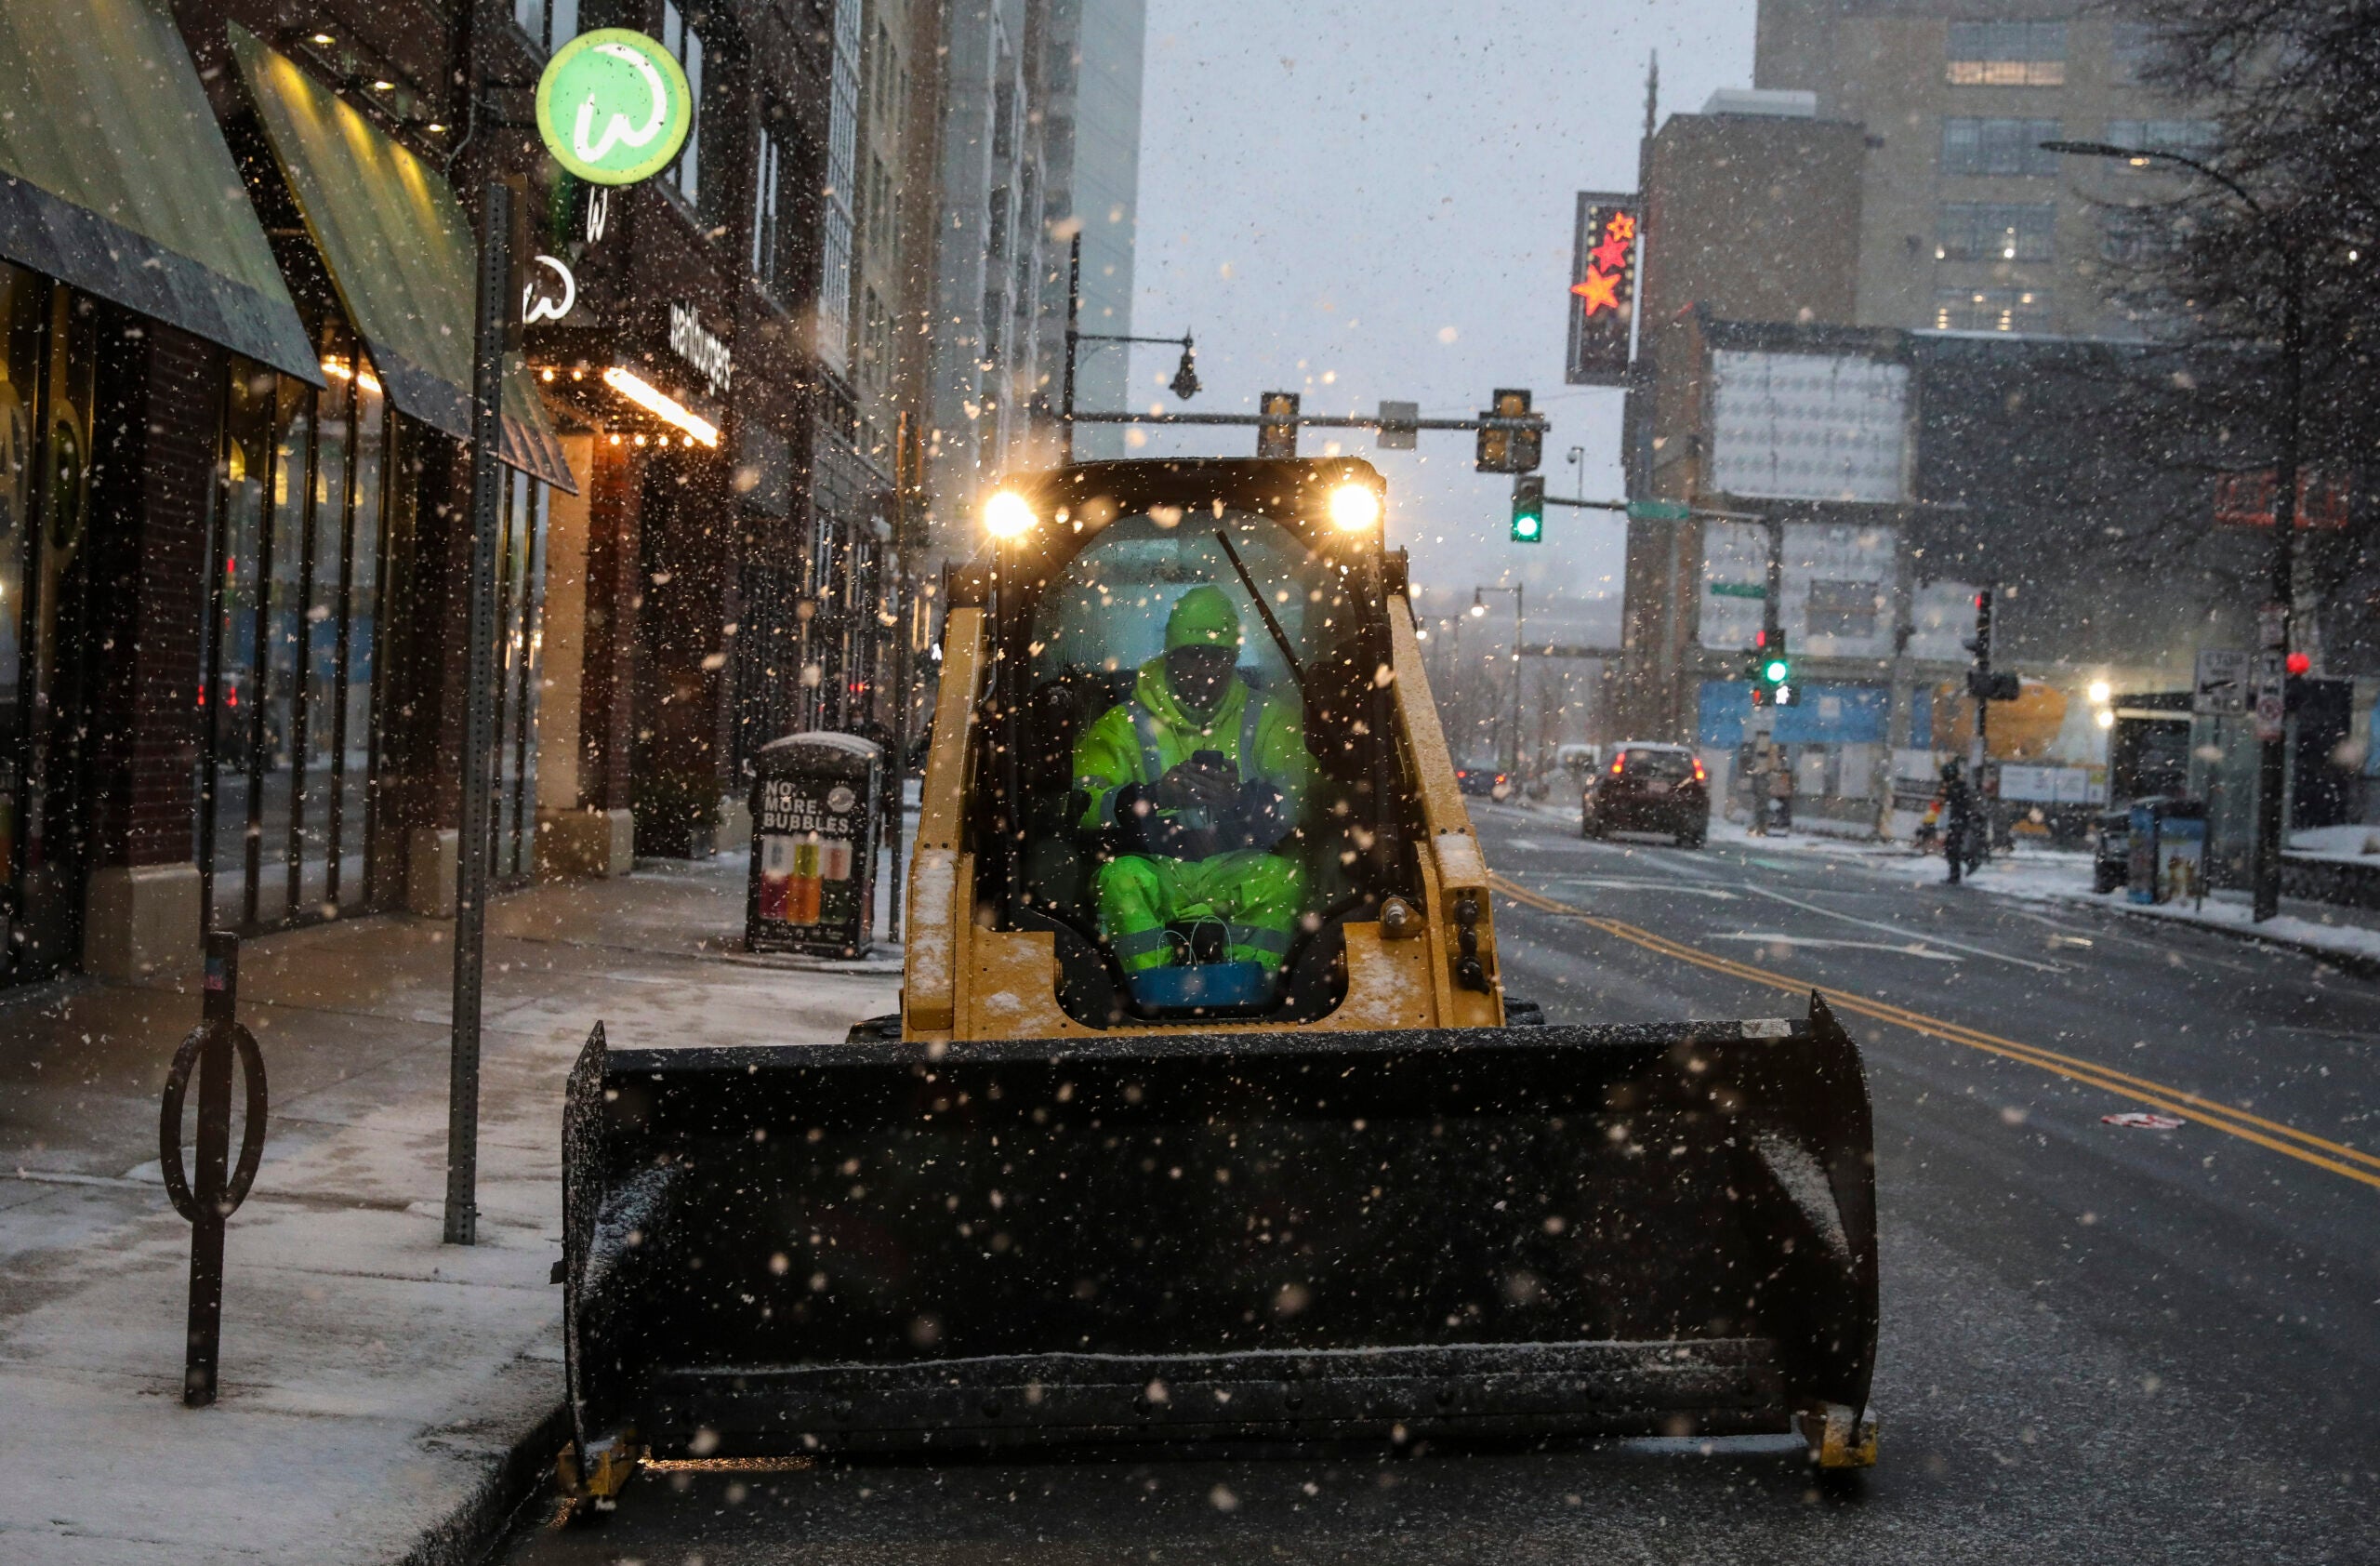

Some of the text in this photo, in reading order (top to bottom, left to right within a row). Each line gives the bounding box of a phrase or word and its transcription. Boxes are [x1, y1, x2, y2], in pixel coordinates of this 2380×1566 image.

[586, 186, 609, 244] W
[765, 780, 797, 797] NO.
[764, 796, 823, 816] MORE.
[763, 812, 855, 834] BUBBLES.
